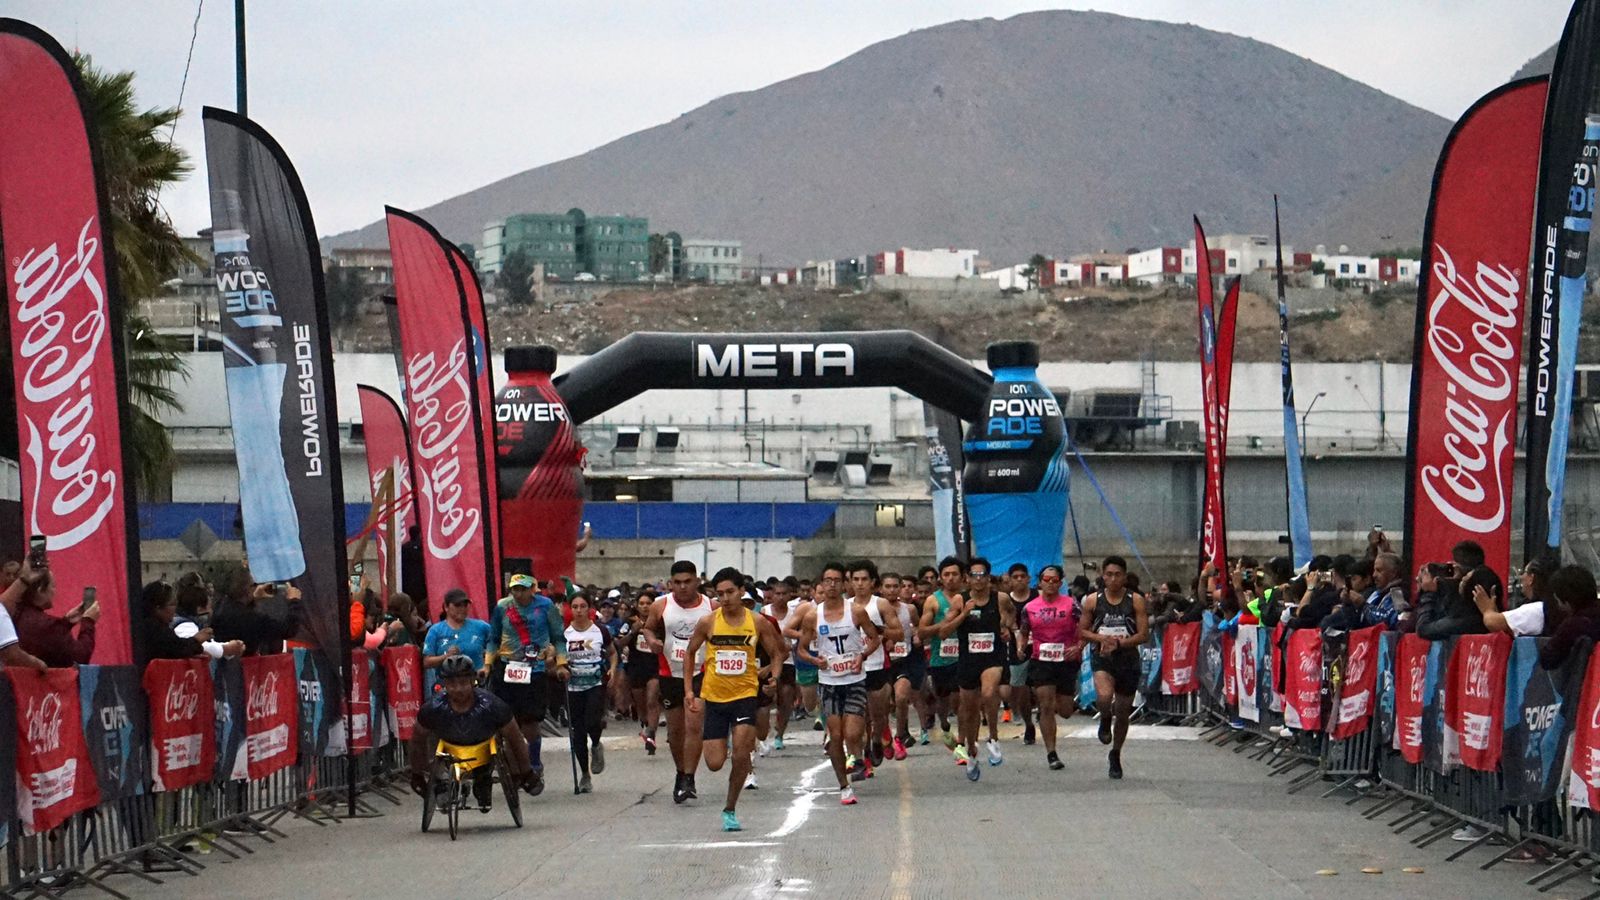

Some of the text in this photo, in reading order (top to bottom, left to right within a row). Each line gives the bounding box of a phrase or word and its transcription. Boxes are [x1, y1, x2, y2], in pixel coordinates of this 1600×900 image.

[1535, 225, 1558, 417] POWERADE
[697, 343, 855, 377] META
[1421, 243, 1521, 533] Coca-Cola
[495, 403, 569, 422] OWER
[497, 422, 524, 440] DE
[987, 417, 1043, 435] ADE
[719, 660, 743, 670] 1529
